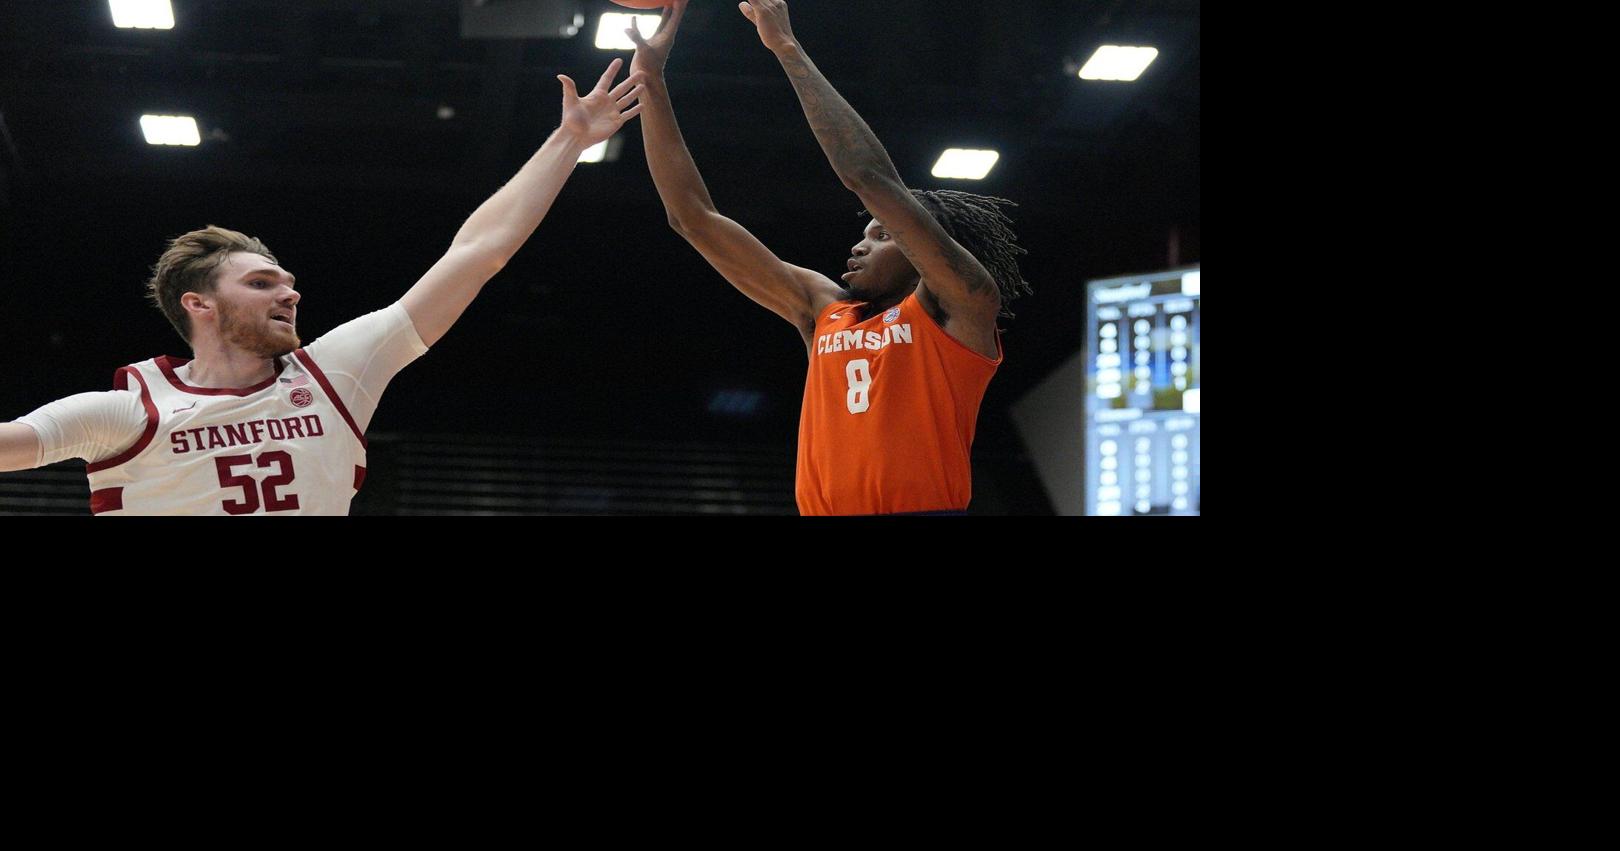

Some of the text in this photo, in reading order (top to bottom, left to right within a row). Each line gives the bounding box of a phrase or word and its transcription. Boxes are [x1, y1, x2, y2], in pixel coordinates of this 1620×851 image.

[846, 358, 872, 415] 8
[170, 414, 324, 454] STANFORD
[215, 450, 300, 515] 52
